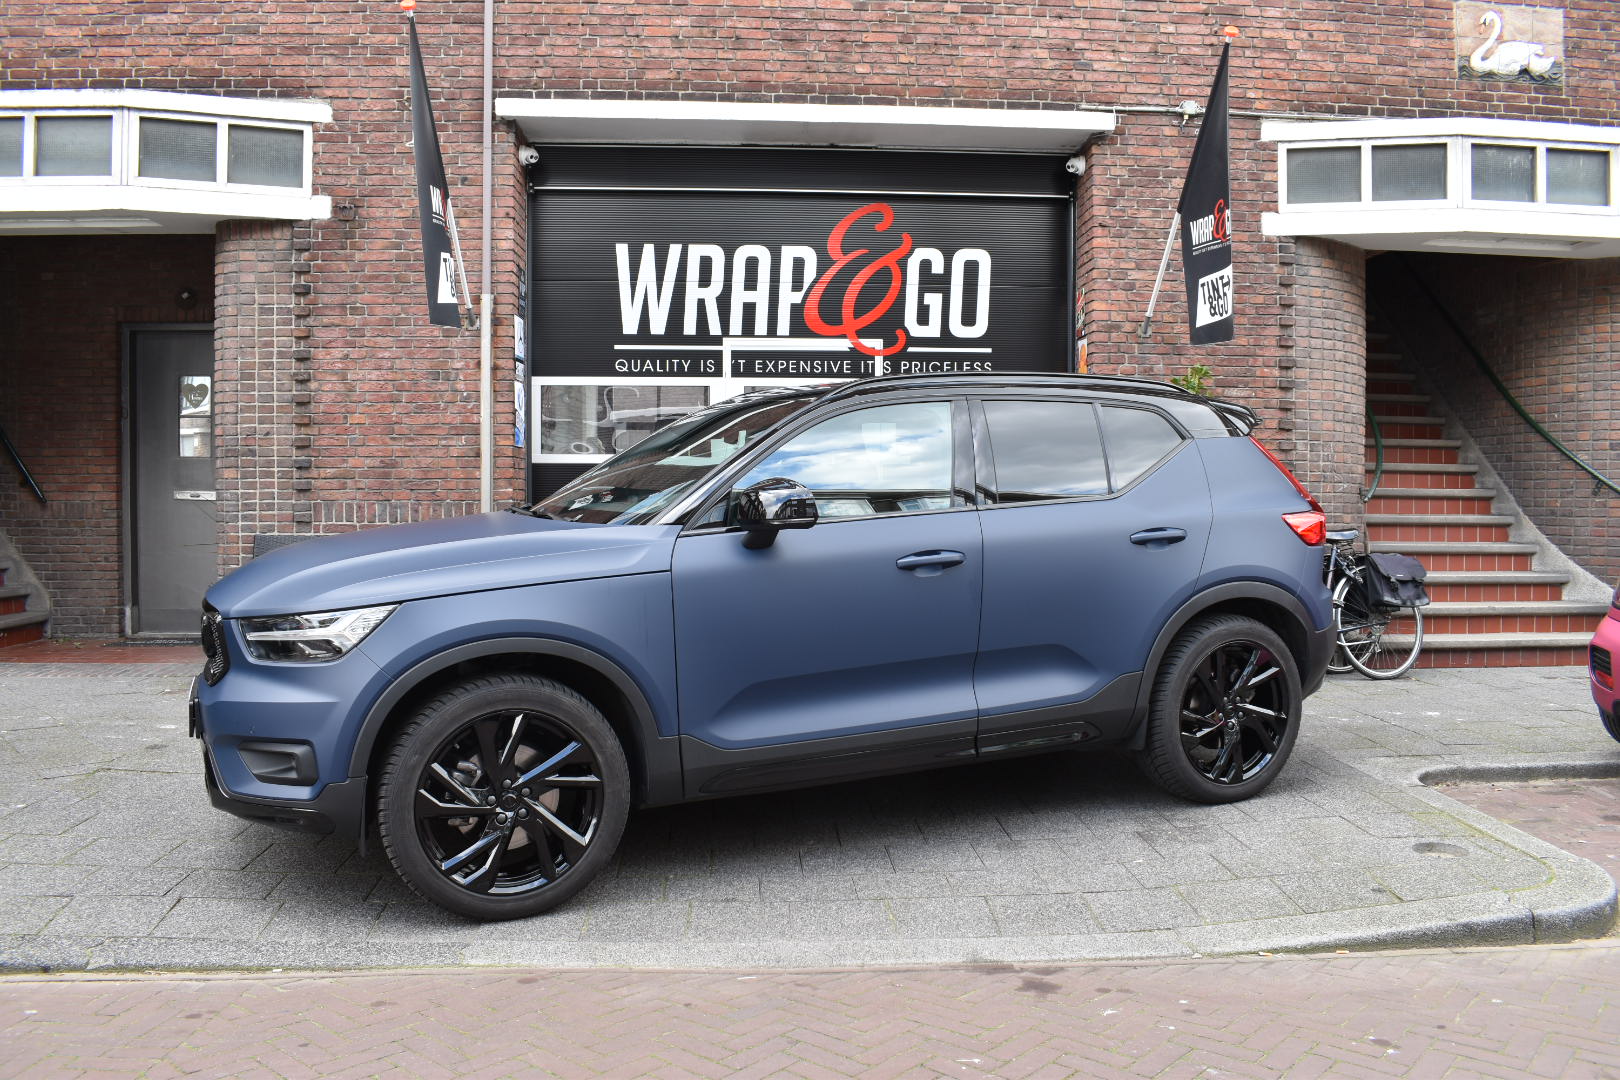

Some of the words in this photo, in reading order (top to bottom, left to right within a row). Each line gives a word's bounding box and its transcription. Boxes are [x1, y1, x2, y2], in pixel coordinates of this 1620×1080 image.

[1189, 214, 1215, 246] WRAP
[615, 243, 818, 337] WRAP
[904, 247, 992, 338] GO
[615, 359, 692, 373] QUALITY
[700, 359, 746, 373] IS'T
[755, 360, 852, 374] EXPENSIVE
[861, 360, 892, 374] ITS
